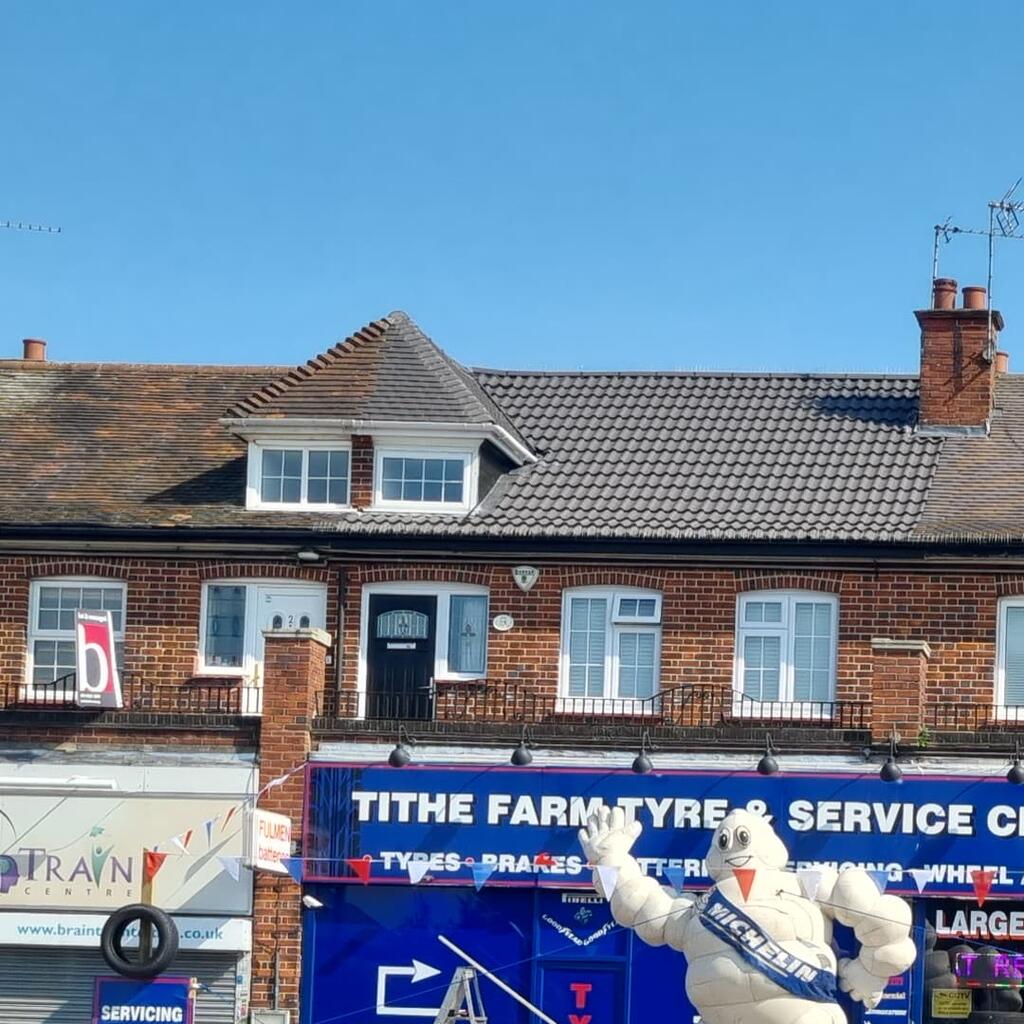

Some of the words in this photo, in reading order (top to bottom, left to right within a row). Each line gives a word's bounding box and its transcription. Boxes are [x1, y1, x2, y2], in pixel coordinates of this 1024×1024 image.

[352, 791, 474, 825] TITHE
[487, 794, 603, 827] FARM
[617, 797, 728, 829] TYRE
[788, 799, 974, 836] SERVICE
[24, 886, 133, 898] CENTRE
[707, 901, 818, 983] MICHELIN
[101, 1005, 183, 1022] SERVICING
